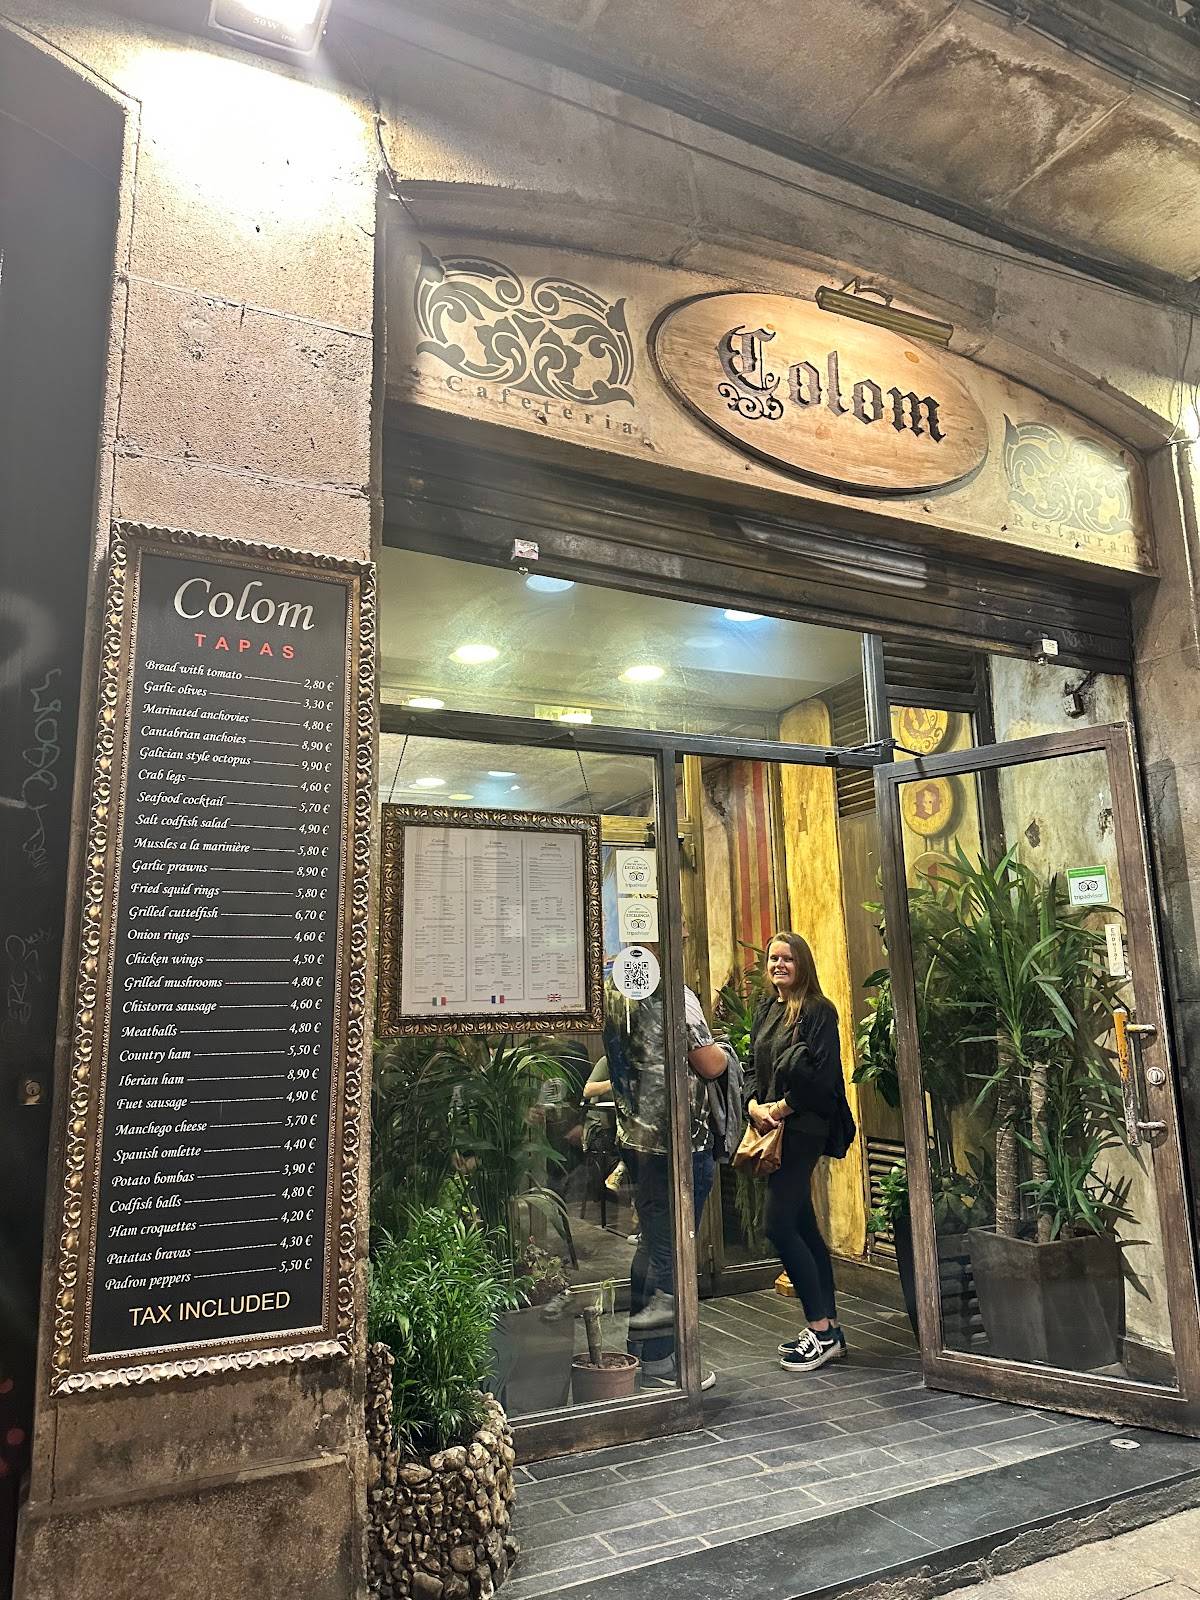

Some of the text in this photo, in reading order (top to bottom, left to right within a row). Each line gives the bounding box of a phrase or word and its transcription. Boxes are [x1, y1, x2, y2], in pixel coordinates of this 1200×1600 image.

[717, 325, 947, 443] Colom
[446, 375, 634, 435] Cafeteria
[174, 578, 314, 630] Colom
[195, 634, 293, 658] TAPAS
[145, 660, 334, 691] Bread with tomato 2,80 €
[144, 681, 333, 711] Garlic olives 3,30 €
[142, 704, 332, 732] Marinated anchovies 4,80 €
[141, 726, 332, 752] Cantabrian anchoies 8,90 €
[140, 747, 332, 772] Galician style octopus 9,90 €
[138, 769, 331, 793] Crab legs 4,60 €
[137, 792, 330, 814] Seafood cocktail 5,70 €
[135, 814, 329, 834] Salt codfish salad 4,90 €
[134, 838, 178, 849] Mussles
[190, 839, 200, 850] la
[203, 842, 250, 852] marinière
[298, 846, 319, 856] 5,80
[322, 847, 328, 856] €
[132, 859, 328, 877] Garlic prawns 8,90 €
[131, 882, 327, 899] Fried squid rings 5,80 €
[129, 905, 326, 921] Grilled cuttelfish 6,70 €
[128, 929, 325, 943] Onion rings 4,60 €
[126, 952, 324, 967] Chicken wings 4,50 €
[124, 976, 323, 991] Grilled mushrooms 4,80 €
[123, 999, 322, 1014] Chistorra sausage 4,60 €
[121, 1022, 321, 1037] Meatballs 4,80 €
[120, 1044, 320, 1063] Country ham 5,50 €
[119, 1068, 319, 1086] Iberian ham 8,90 €
[117, 1090, 318, 1111] Fuet sausage 4,90 €
[115, 1114, 317, 1137] Manchego cheese 5,70 €
[113, 1138, 316, 1164] Spanish omlette 4,40 €
[112, 1162, 315, 1186] Potato bombas 3,90 €
[110, 1186, 314, 1214] Codfish balls 4,80 €
[108, 1209, 314, 1238] Ham croquettes 4,20 €
[107, 1235, 313, 1264] Patatas bravas 4,30 €
[105, 1258, 312, 1290] Padron peppers 5,50 €
[129, 1292, 290, 1326] TAX INCLUDED
